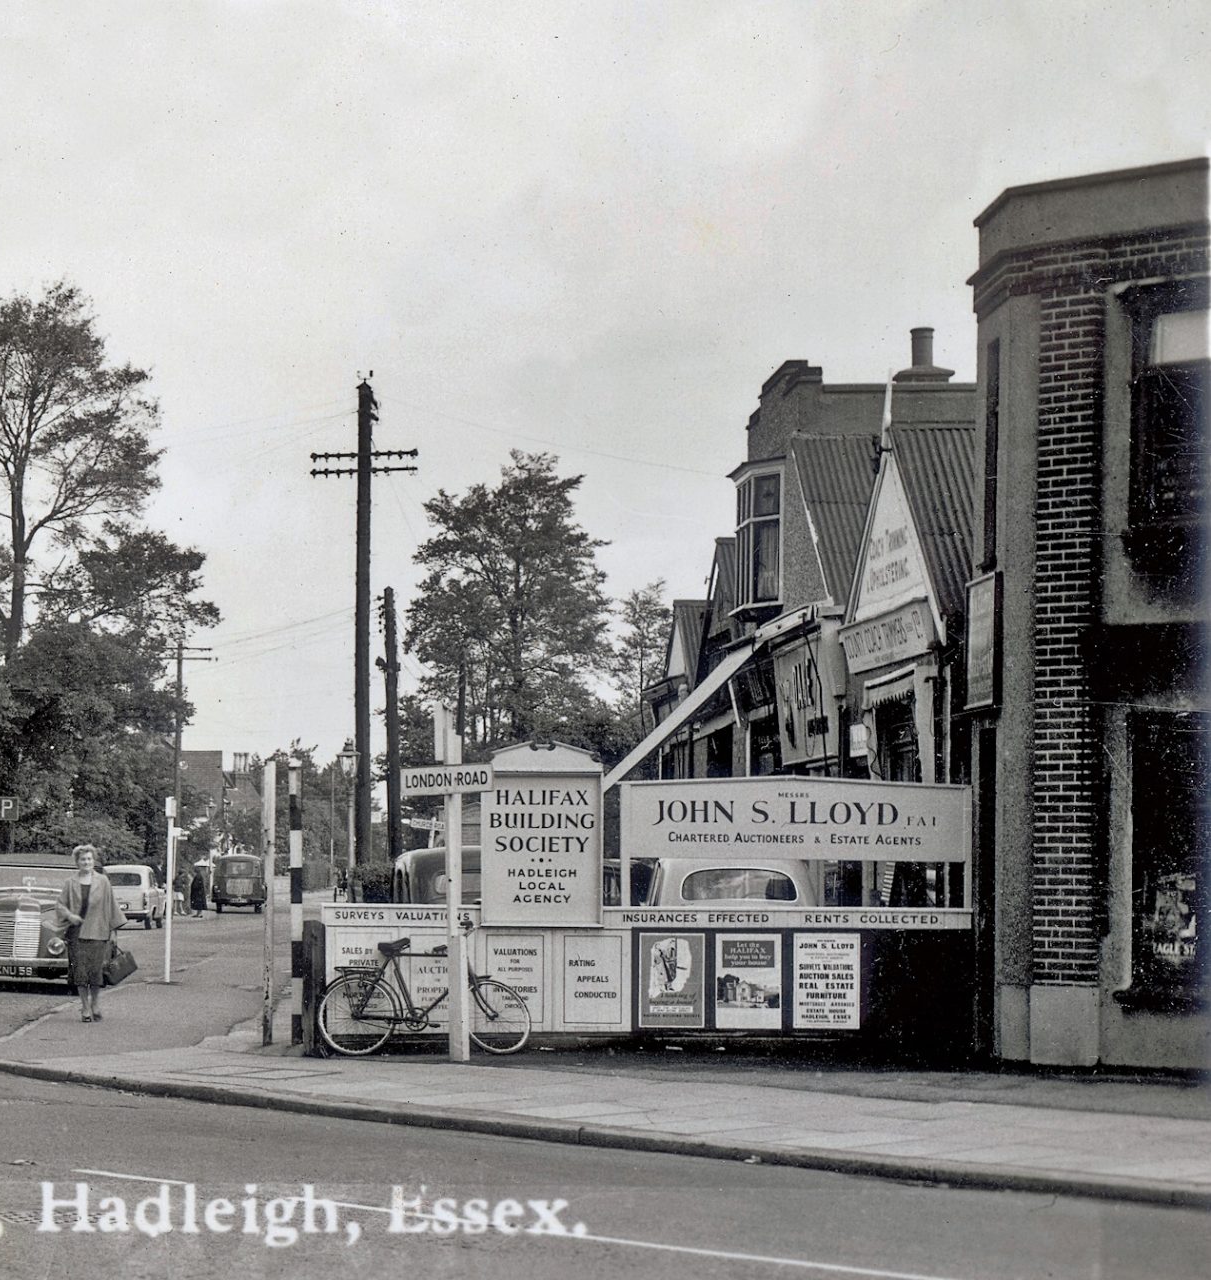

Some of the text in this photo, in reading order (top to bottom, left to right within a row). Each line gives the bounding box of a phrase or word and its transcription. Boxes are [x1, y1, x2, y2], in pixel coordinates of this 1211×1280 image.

[405, 770, 488, 788] LONDON ROAD
[496, 789, 589, 806] HALIFAX
[1, 799, 13, 818] P
[652, 800, 734, 825] JOHN
[751, 800, 776, 824] S.
[789, 800, 899, 826] LLOYD
[490, 813, 595, 829] BUILDING
[668, 831, 922, 846] CHARTERED AUCTIONEERS & ESTATE AGENTS
[495, 836, 589, 853] SOCIETY
[507, 868, 577, 878] HADLEIGH
[519, 882, 566, 891] LOCAL
[513, 895, 572, 904] AGENCY
[335, 911, 470, 921] SURVEYS VALUATIS
[622, 914, 698, 924] INSURANCES
[708, 914, 770, 924] EFFECTED
[804, 914, 850, 924] RENTS
[342, 947, 363, 955] SALES
[493, 948, 538, 956] VALUATIONS
[349, 959, 379, 967] PRIVATE
[569, 959, 595, 967] RATING
[417, 966, 448, 975] AUCTI
[577, 975, 609, 983] APPEALS
[574, 991, 617, 999] CONDUCTED
